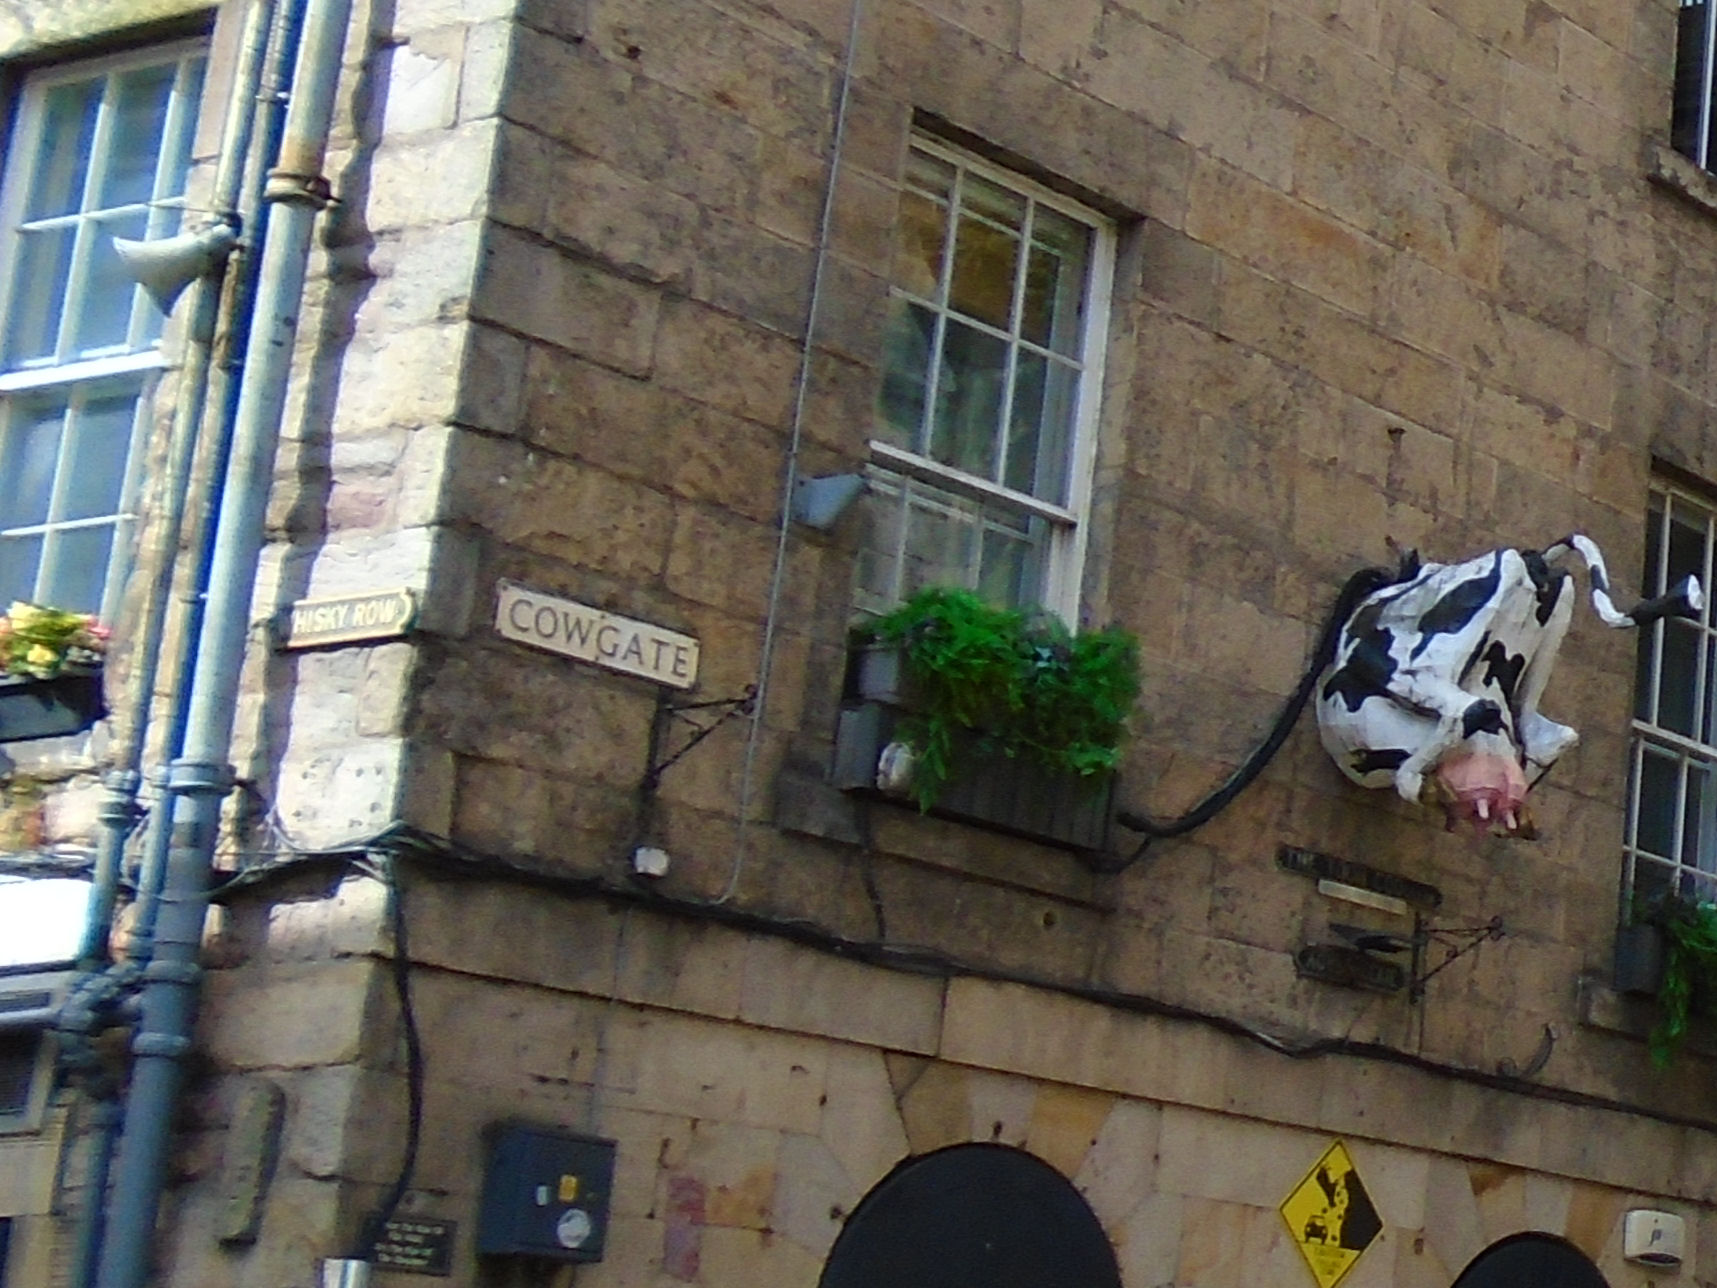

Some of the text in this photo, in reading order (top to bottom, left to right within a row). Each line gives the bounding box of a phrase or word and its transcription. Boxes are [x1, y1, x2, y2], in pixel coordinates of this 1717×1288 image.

[293, 598, 397, 634] HISKY ROW
[509, 598, 690, 678] COWGATE
